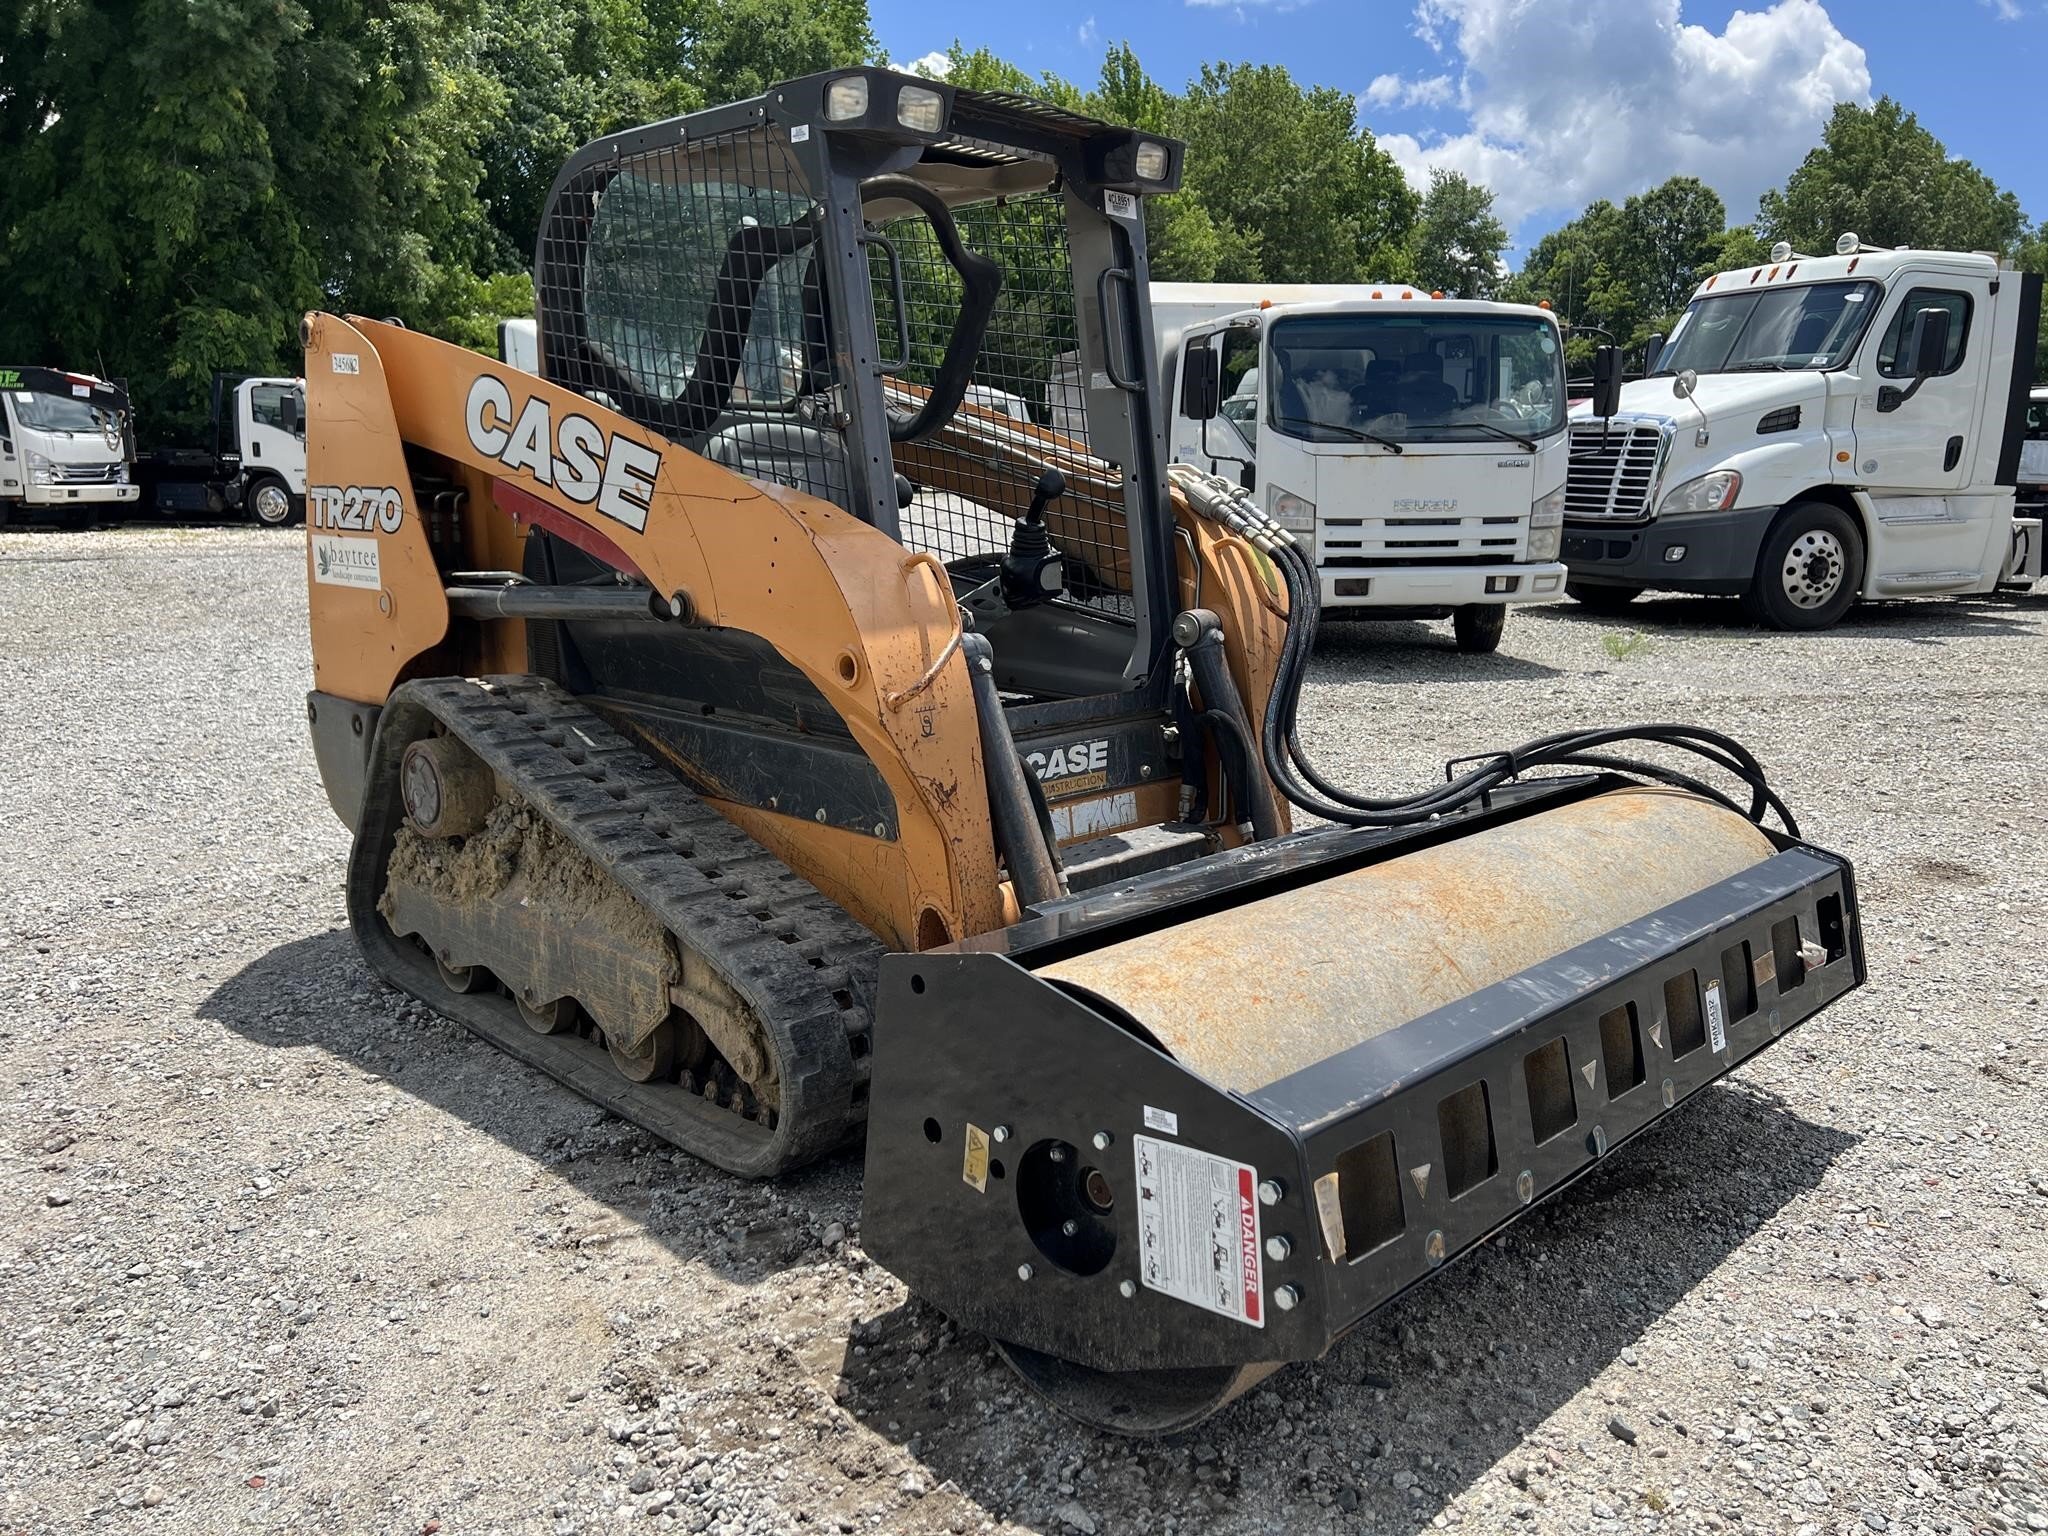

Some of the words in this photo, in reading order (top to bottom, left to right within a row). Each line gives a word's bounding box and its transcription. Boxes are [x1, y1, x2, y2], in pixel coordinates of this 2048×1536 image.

[465, 373, 662, 536] CASE
[310, 485, 404, 534] TR270
[1393, 499, 1458, 513] ISUZU
[330, 541, 377, 571] baytree
[1025, 740, 1109, 780] CASE
[1042, 774, 1104, 795] ONSTRUCTION
[1241, 1213, 1258, 1294] DANGER
